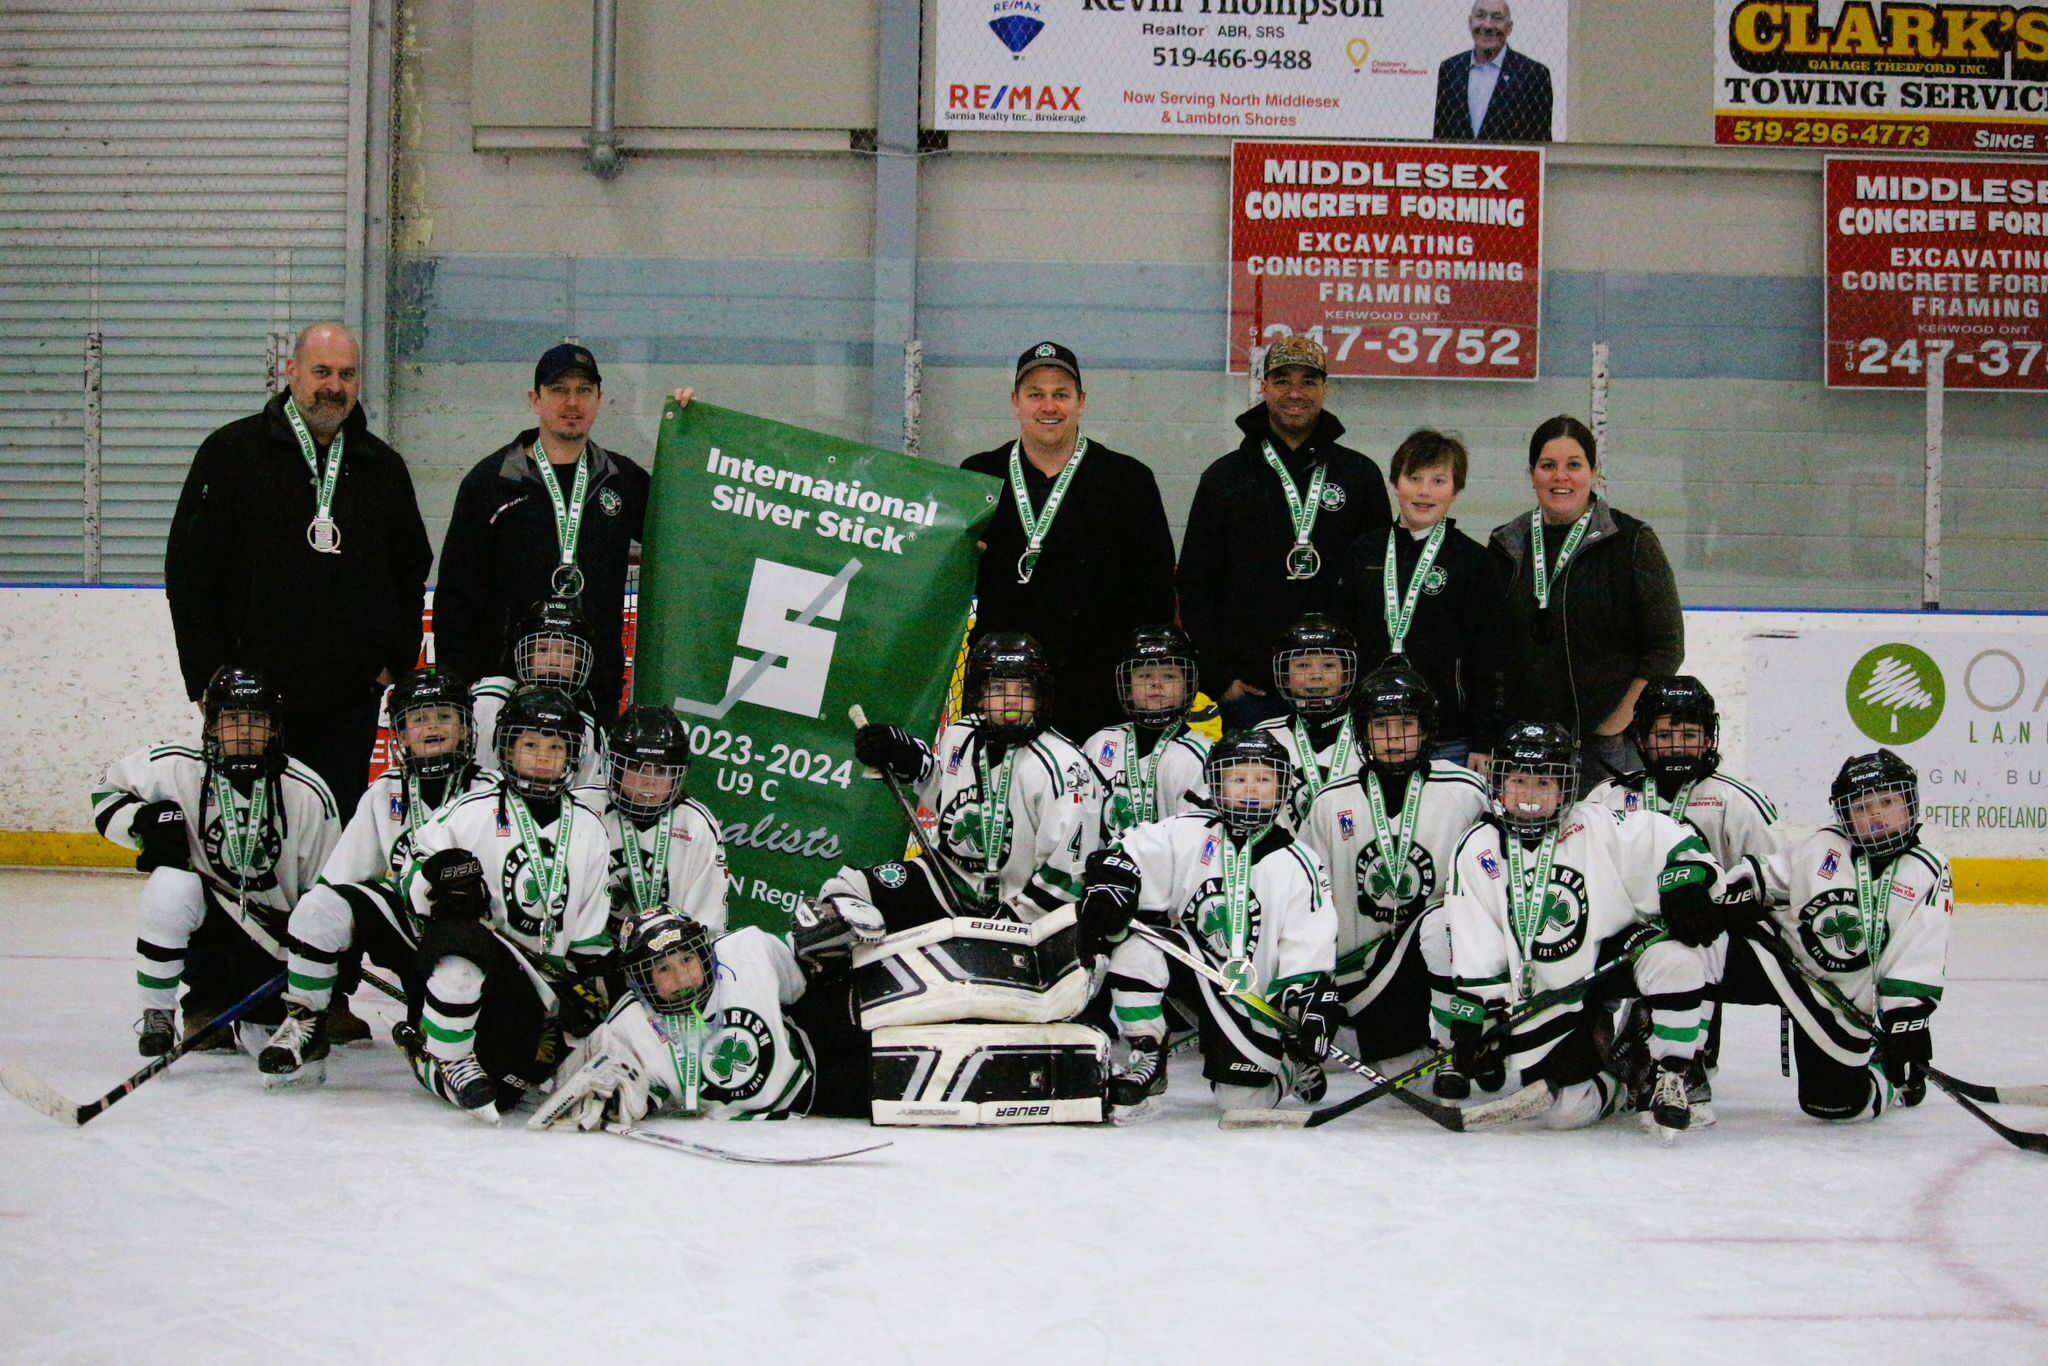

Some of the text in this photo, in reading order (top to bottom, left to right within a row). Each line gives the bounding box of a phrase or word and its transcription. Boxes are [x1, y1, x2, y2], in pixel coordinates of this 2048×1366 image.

[1142, 23, 1205, 37] Realtor
[1256, 26, 1285, 39] SRS
[1733, 2, 2048, 61] CLARK'S
[1153, 47, 1312, 69] 519-466-9488
[1808, 60, 1988, 75] GARAGE THEDFORD INC.
[949, 84, 1081, 111] RE/MAX
[1123, 90, 1340, 108] Now Serving North Middlesex
[1725, 78, 2048, 112] TOWING SERVIC
[944, 111, 976, 121] Sarnia
[978, 112, 1009, 123] Realty
[1035, 113, 1087, 124] Brokerage
[1161, 110, 1297, 126] & Lambton Shores
[1734, 121, 1931, 147] 519-296-4773
[1974, 130, 2035, 149] SINCE
[1264, 159, 1509, 190] MIDDLESEX
[1245, 191, 1525, 227] CONCRETE FORMING
[1838, 207, 1977, 236] CONCRETE
[1298, 232, 1474, 256] EXCAVATING
[1247, 255, 1524, 281] CONCRETE FORMING
[1319, 282, 1451, 305] FRAMING
[1842, 271, 1978, 293] CONCRETE
[1325, 309, 1404, 321] KERWOOD
[1912, 297, 2040, 318] FRAMING
[1918, 324, 1994, 335] KERWOOD
[1859, 337, 2048, 377] 247-37
[706, 447, 938, 527] International
[711, 484, 810, 530] Silver
[1969, 720, 2048, 745] LAN
[716, 767, 779, 802] U9 C
[719, 812, 842, 860] alists
[751, 879, 804, 913] Regi
[970, 920, 1029, 936] BAUER
